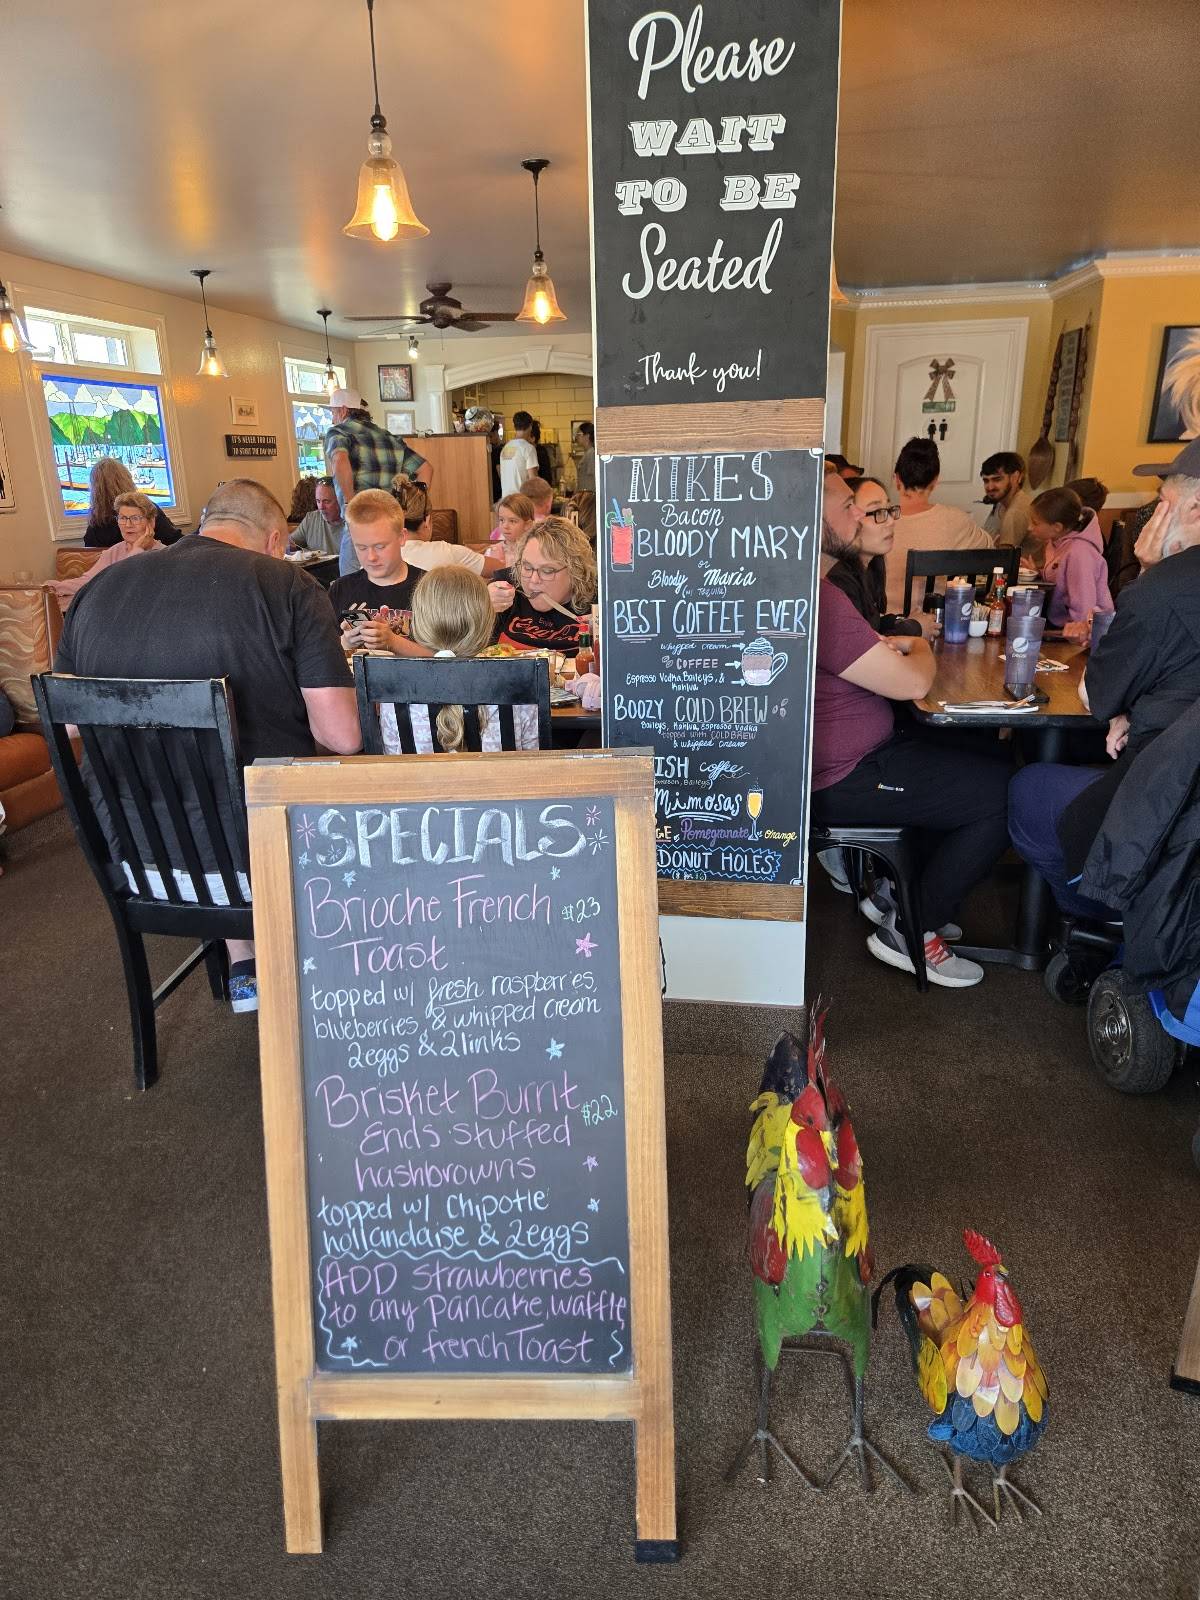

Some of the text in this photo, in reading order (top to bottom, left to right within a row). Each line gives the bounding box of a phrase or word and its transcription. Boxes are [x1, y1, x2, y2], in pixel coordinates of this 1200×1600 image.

[628, 4, 796, 100] Please
[628, 113, 786, 157] WAIT
[615, 172, 800, 216] TO BE
[622, 217, 783, 300] Seated
[638, 349, 762, 392] Thank you!
[628, 451, 773, 502] MIKES
[661, 503, 724, 527] Bacon
[637, 525, 809, 560] BLOODY MARY
[647, 566, 757, 595] Bloody Maria
[613, 599, 666, 634] BEST
[672, 599, 746, 634] COFFEE
[756, 599, 809, 633] EVER
[660, 643, 697, 655] whipped
[676, 658, 719, 670] COFFEE
[626, 672, 657, 687] Espresso
[614, 694, 768, 723] BOOZY COLD BREW
[681, 740, 715, 751] whipped
[711, 731, 730, 740] COLD
[730, 731, 757, 740] BREW
[655, 756, 744, 780] ISH coffee
[655, 787, 742, 817] Mimosas
[316, 804, 587, 868] SPECIALS
[680, 818, 750, 847] Pomegranate
[657, 849, 775, 874] DONUT HOLES
[304, 874, 601, 939] Brioche French $23
[328, 936, 450, 976] Toast
[310, 979, 386, 1018] topped
[393, 981, 414, 1007] w/
[425, 976, 485, 1019] fresh
[312, 995, 601, 1040] blueberries & whipped cream
[418, 1028, 438, 1057] &
[316, 1068, 618, 1128] Brisket Burnt $22
[359, 1115, 441, 1156] Ends
[355, 1155, 536, 1192] hashbrowns
[316, 1194, 392, 1227] topped
[403, 1194, 430, 1222] w/
[322, 1219, 465, 1254] hollandaise
[478, 1222, 499, 1247] &
[324, 1261, 398, 1298] ADD
[328, 1301, 356, 1329] to
[369, 1296, 418, 1332] any
[384, 1336, 406, 1360] or
[505, 1323, 594, 1364] Toast
